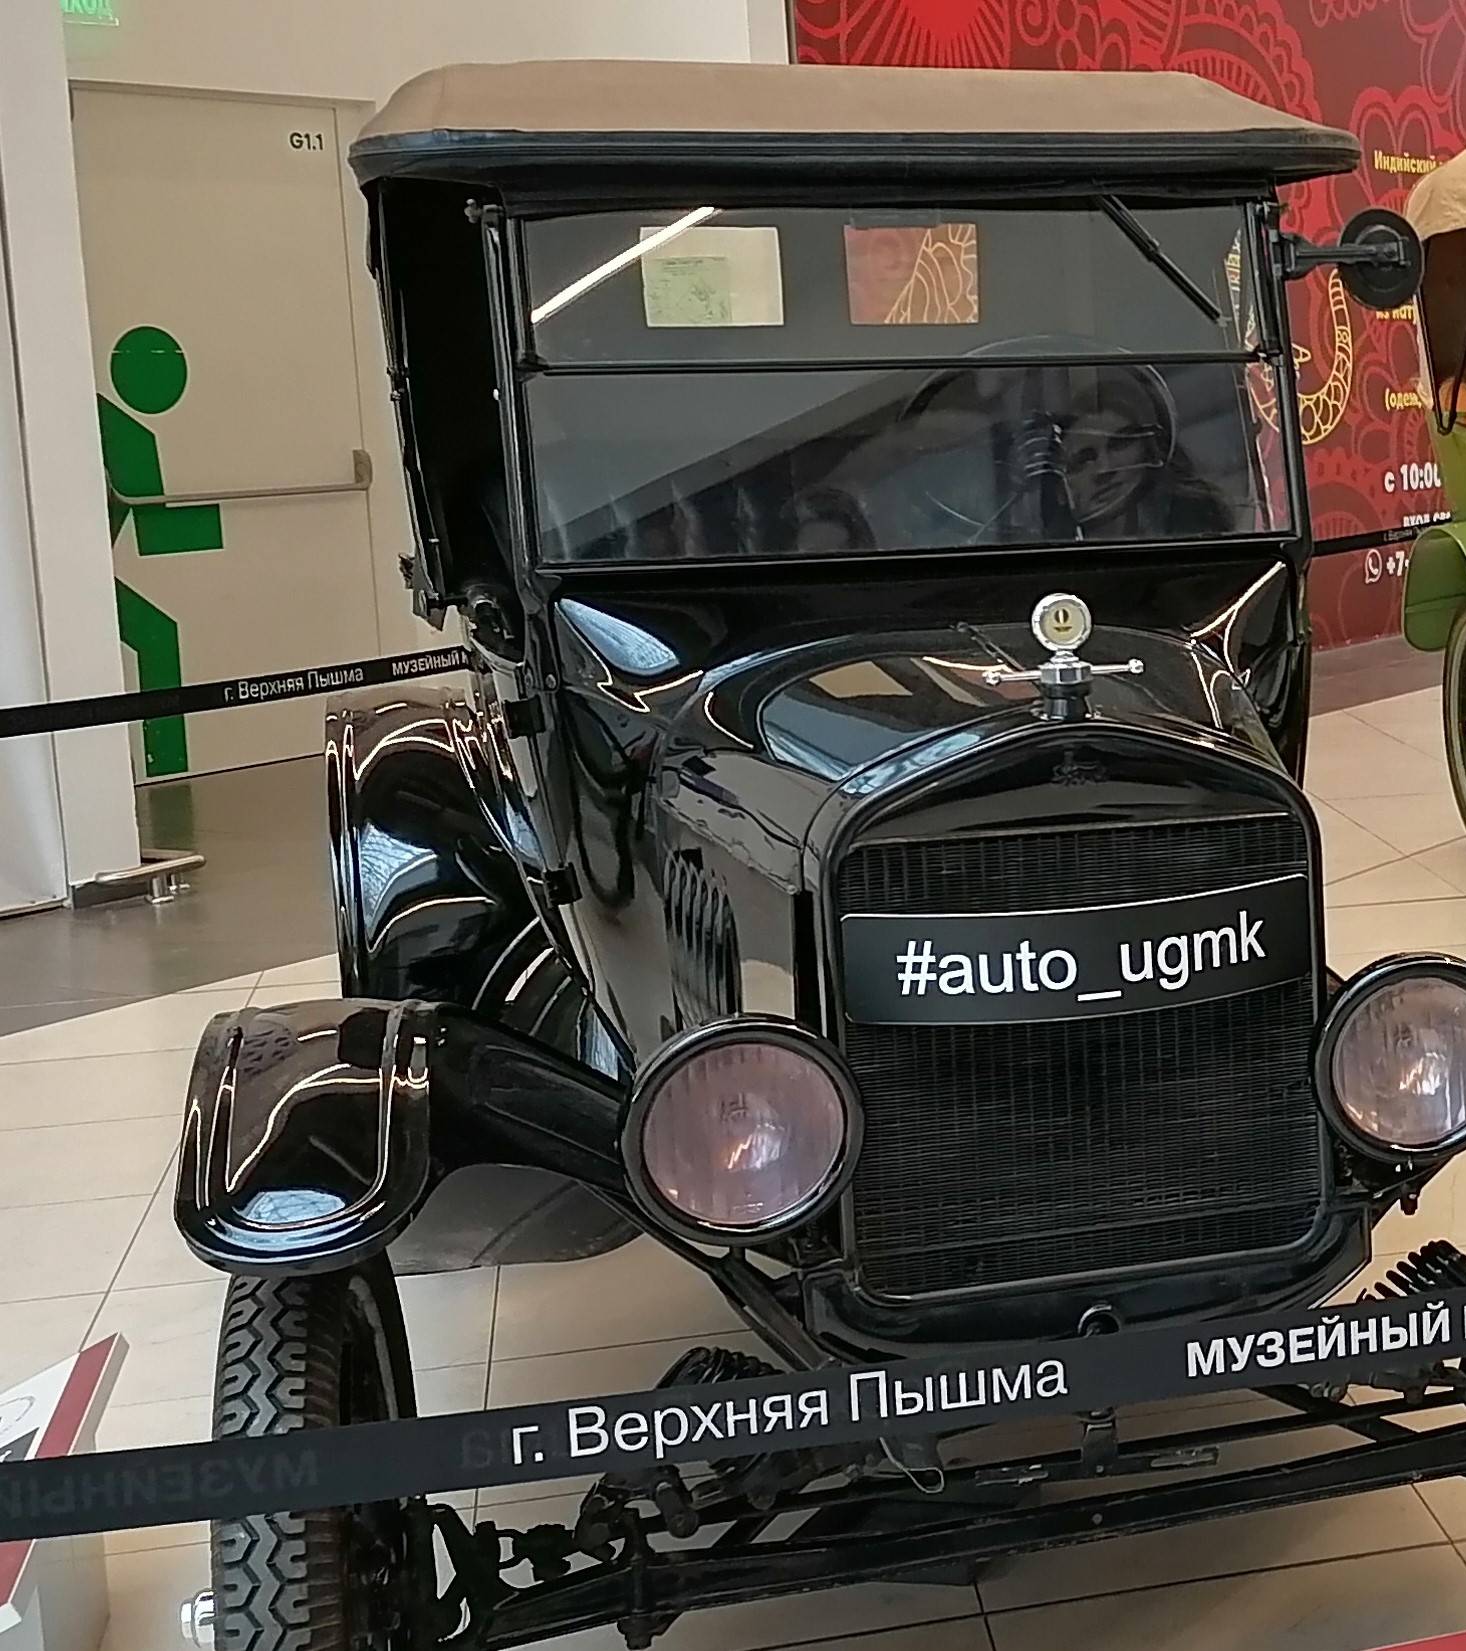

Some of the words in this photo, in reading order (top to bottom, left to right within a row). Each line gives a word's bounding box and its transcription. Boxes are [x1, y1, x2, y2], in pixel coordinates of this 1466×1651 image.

[290, 132, 323, 150] G1.1
[392, 650, 460, 676] МУЗЕЙНЫЙ
[238, 677, 304, 700] Верхняя
[308, 667, 364, 690] Пышма
[1187, 1300, 1450, 1377] МУЗЕЙНЫЙ
[512, 1425, 544, 1465] г.
[568, 1390, 829, 1459] Верхняя
[850, 1360, 1069, 1422] Пышма
